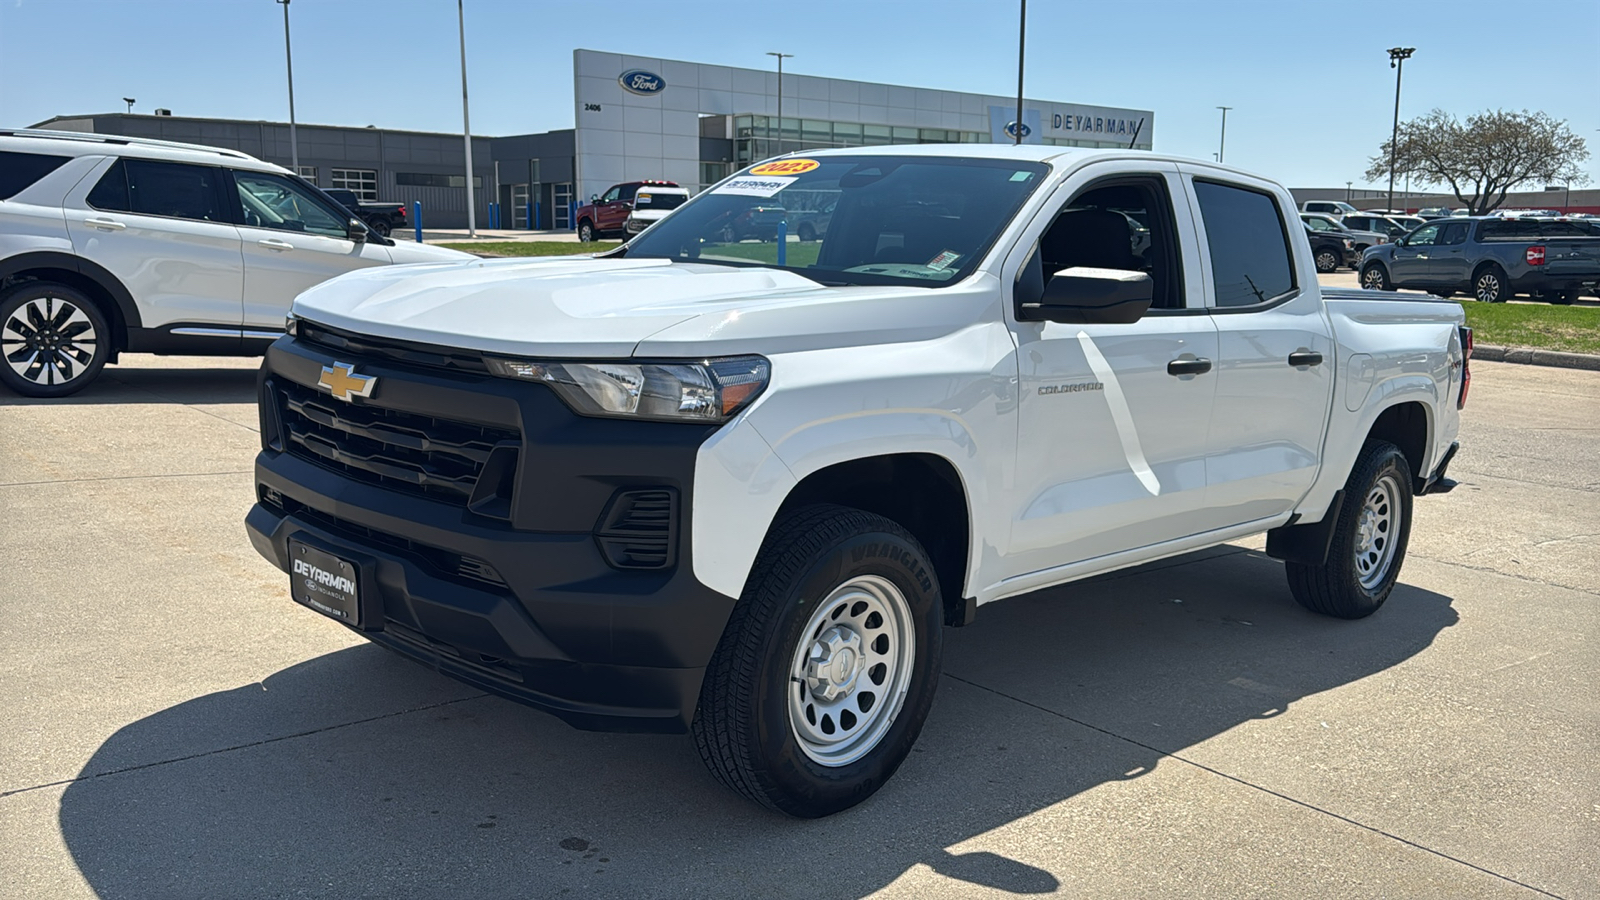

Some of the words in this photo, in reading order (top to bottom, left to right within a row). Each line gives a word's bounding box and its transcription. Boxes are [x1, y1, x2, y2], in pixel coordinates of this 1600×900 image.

[631, 74, 659, 91] Ford
[584, 103, 602, 112] 2406
[1053, 114, 1137, 135] DEYARMAN
[754, 162, 815, 172] 2023
[1038, 382, 1104, 396] COLORADO
[851, 543, 932, 593] WRANGLER
[293, 558, 355, 596] DEYARMAN
[317, 586, 346, 601] INDIANOLA
